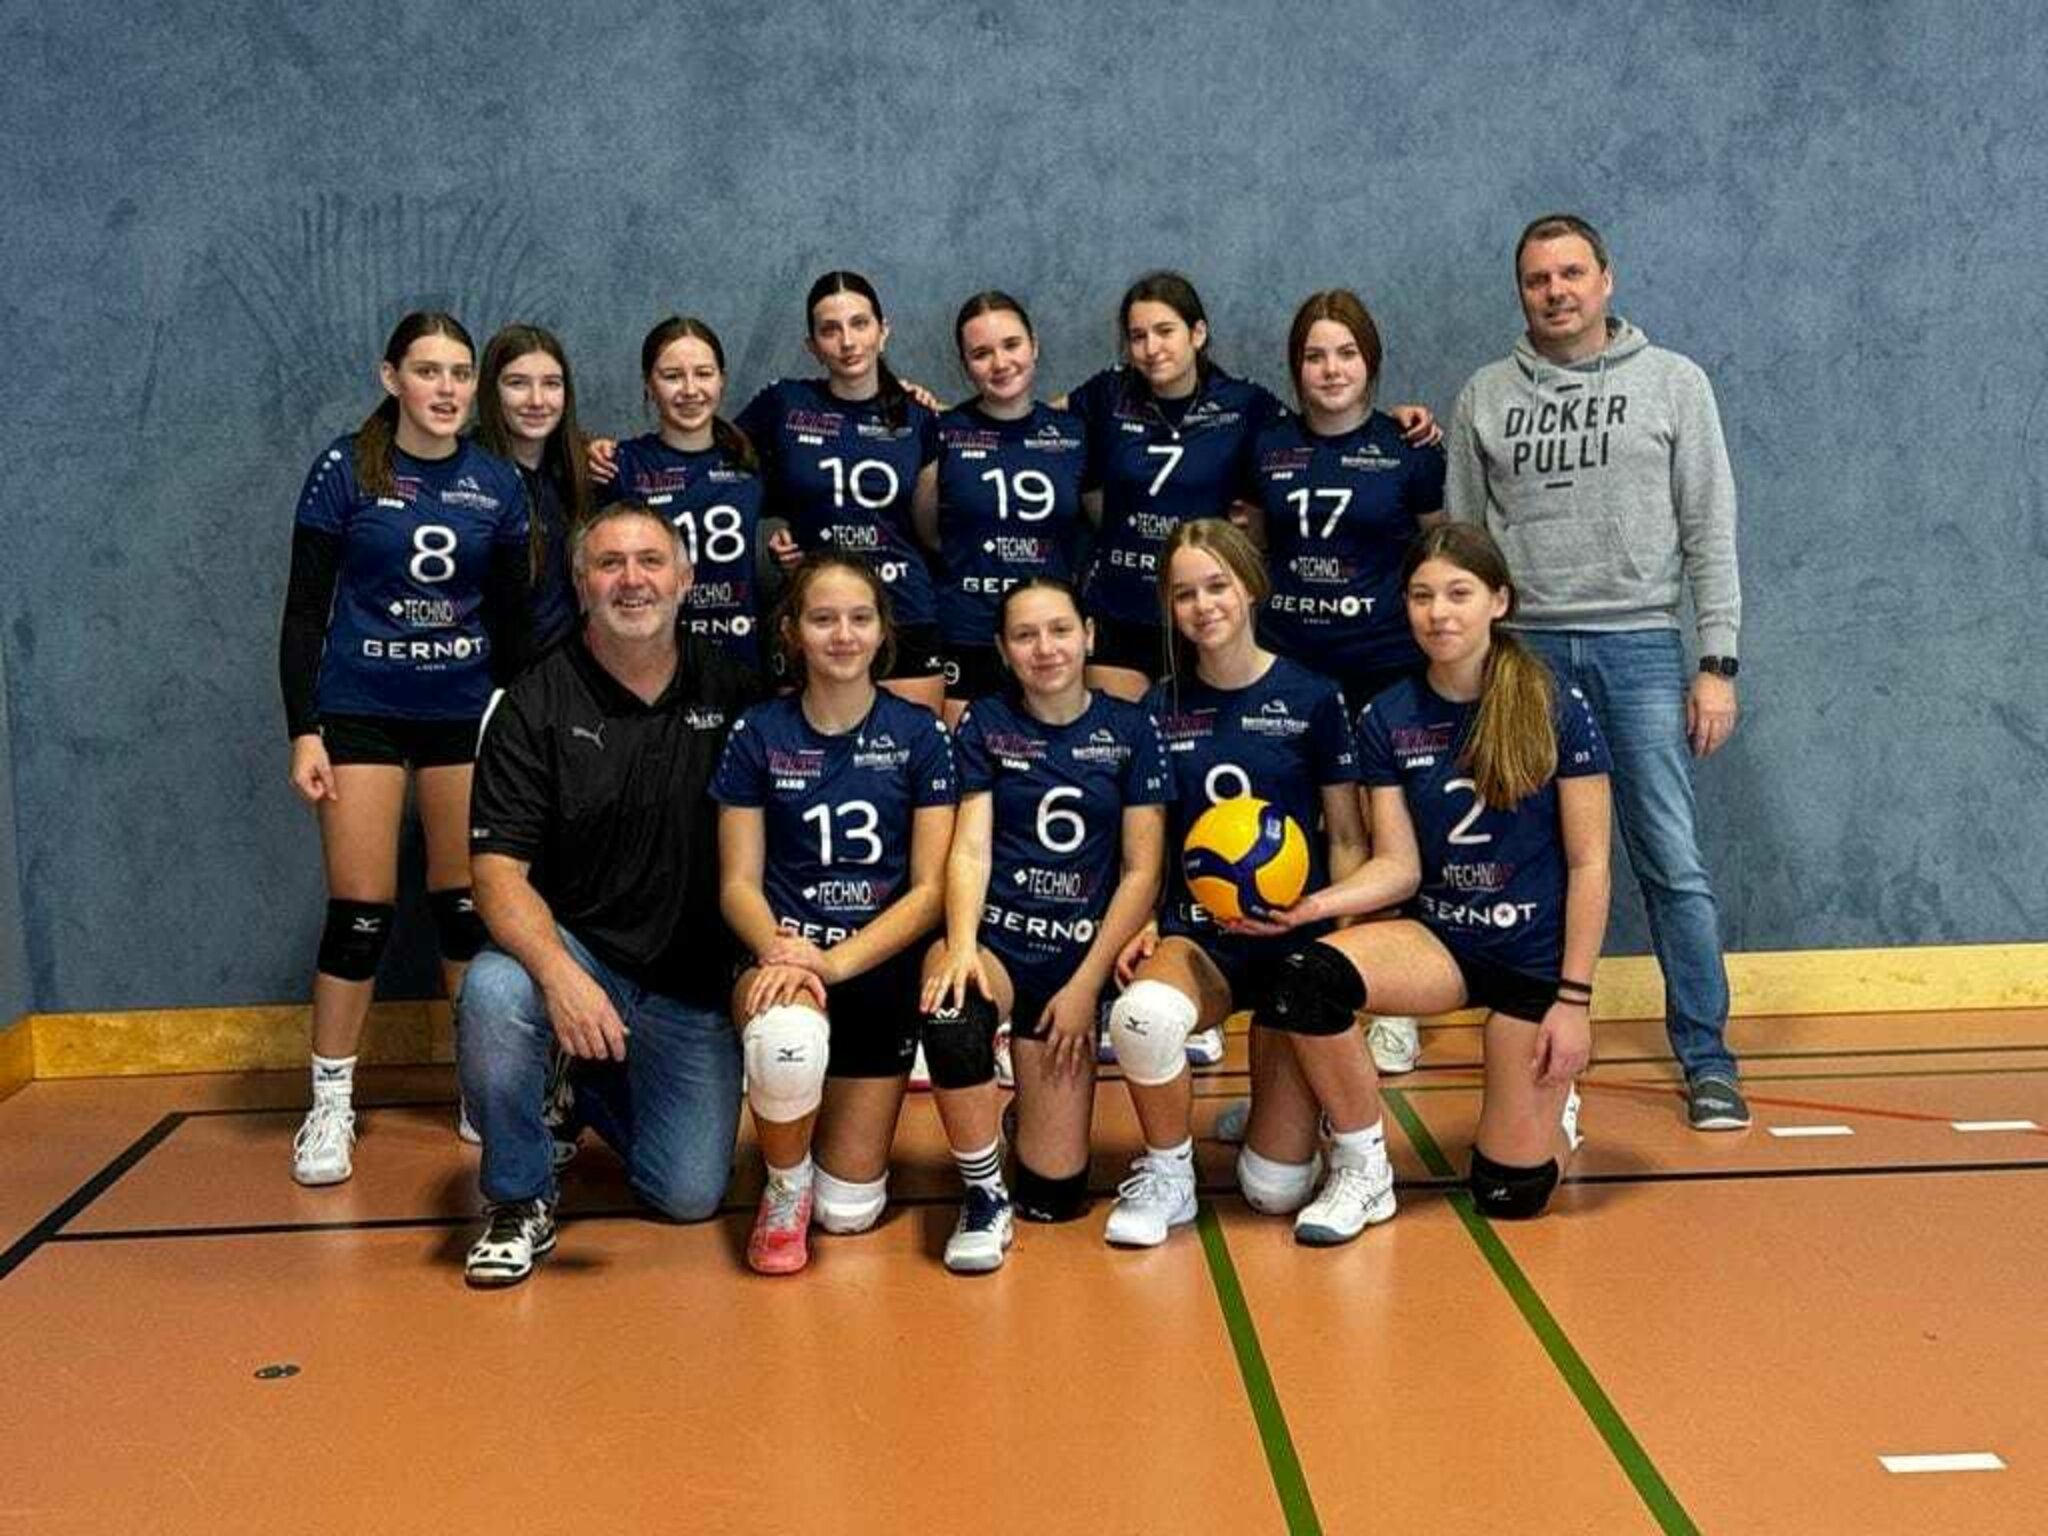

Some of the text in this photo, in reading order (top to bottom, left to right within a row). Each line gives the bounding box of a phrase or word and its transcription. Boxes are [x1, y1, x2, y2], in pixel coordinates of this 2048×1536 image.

[1504, 395, 1628, 438] DICKER
[1147, 445, 1185, 497] 7
[1513, 432, 1610, 476] PULLI
[819, 456, 900, 509] 10
[981, 468, 1056, 522] 19
[673, 504, 746, 564] 18
[1287, 487, 1354, 540] 17
[409, 523, 458, 584] 8
[1271, 594, 1376, 617] GERNOT
[362, 637, 484, 660] GERNOT
[802, 799, 884, 867] 13
[1036, 786, 1087, 854] 6
[1444, 777, 1493, 845] 2
[983, 904, 1094, 943] GERNO
